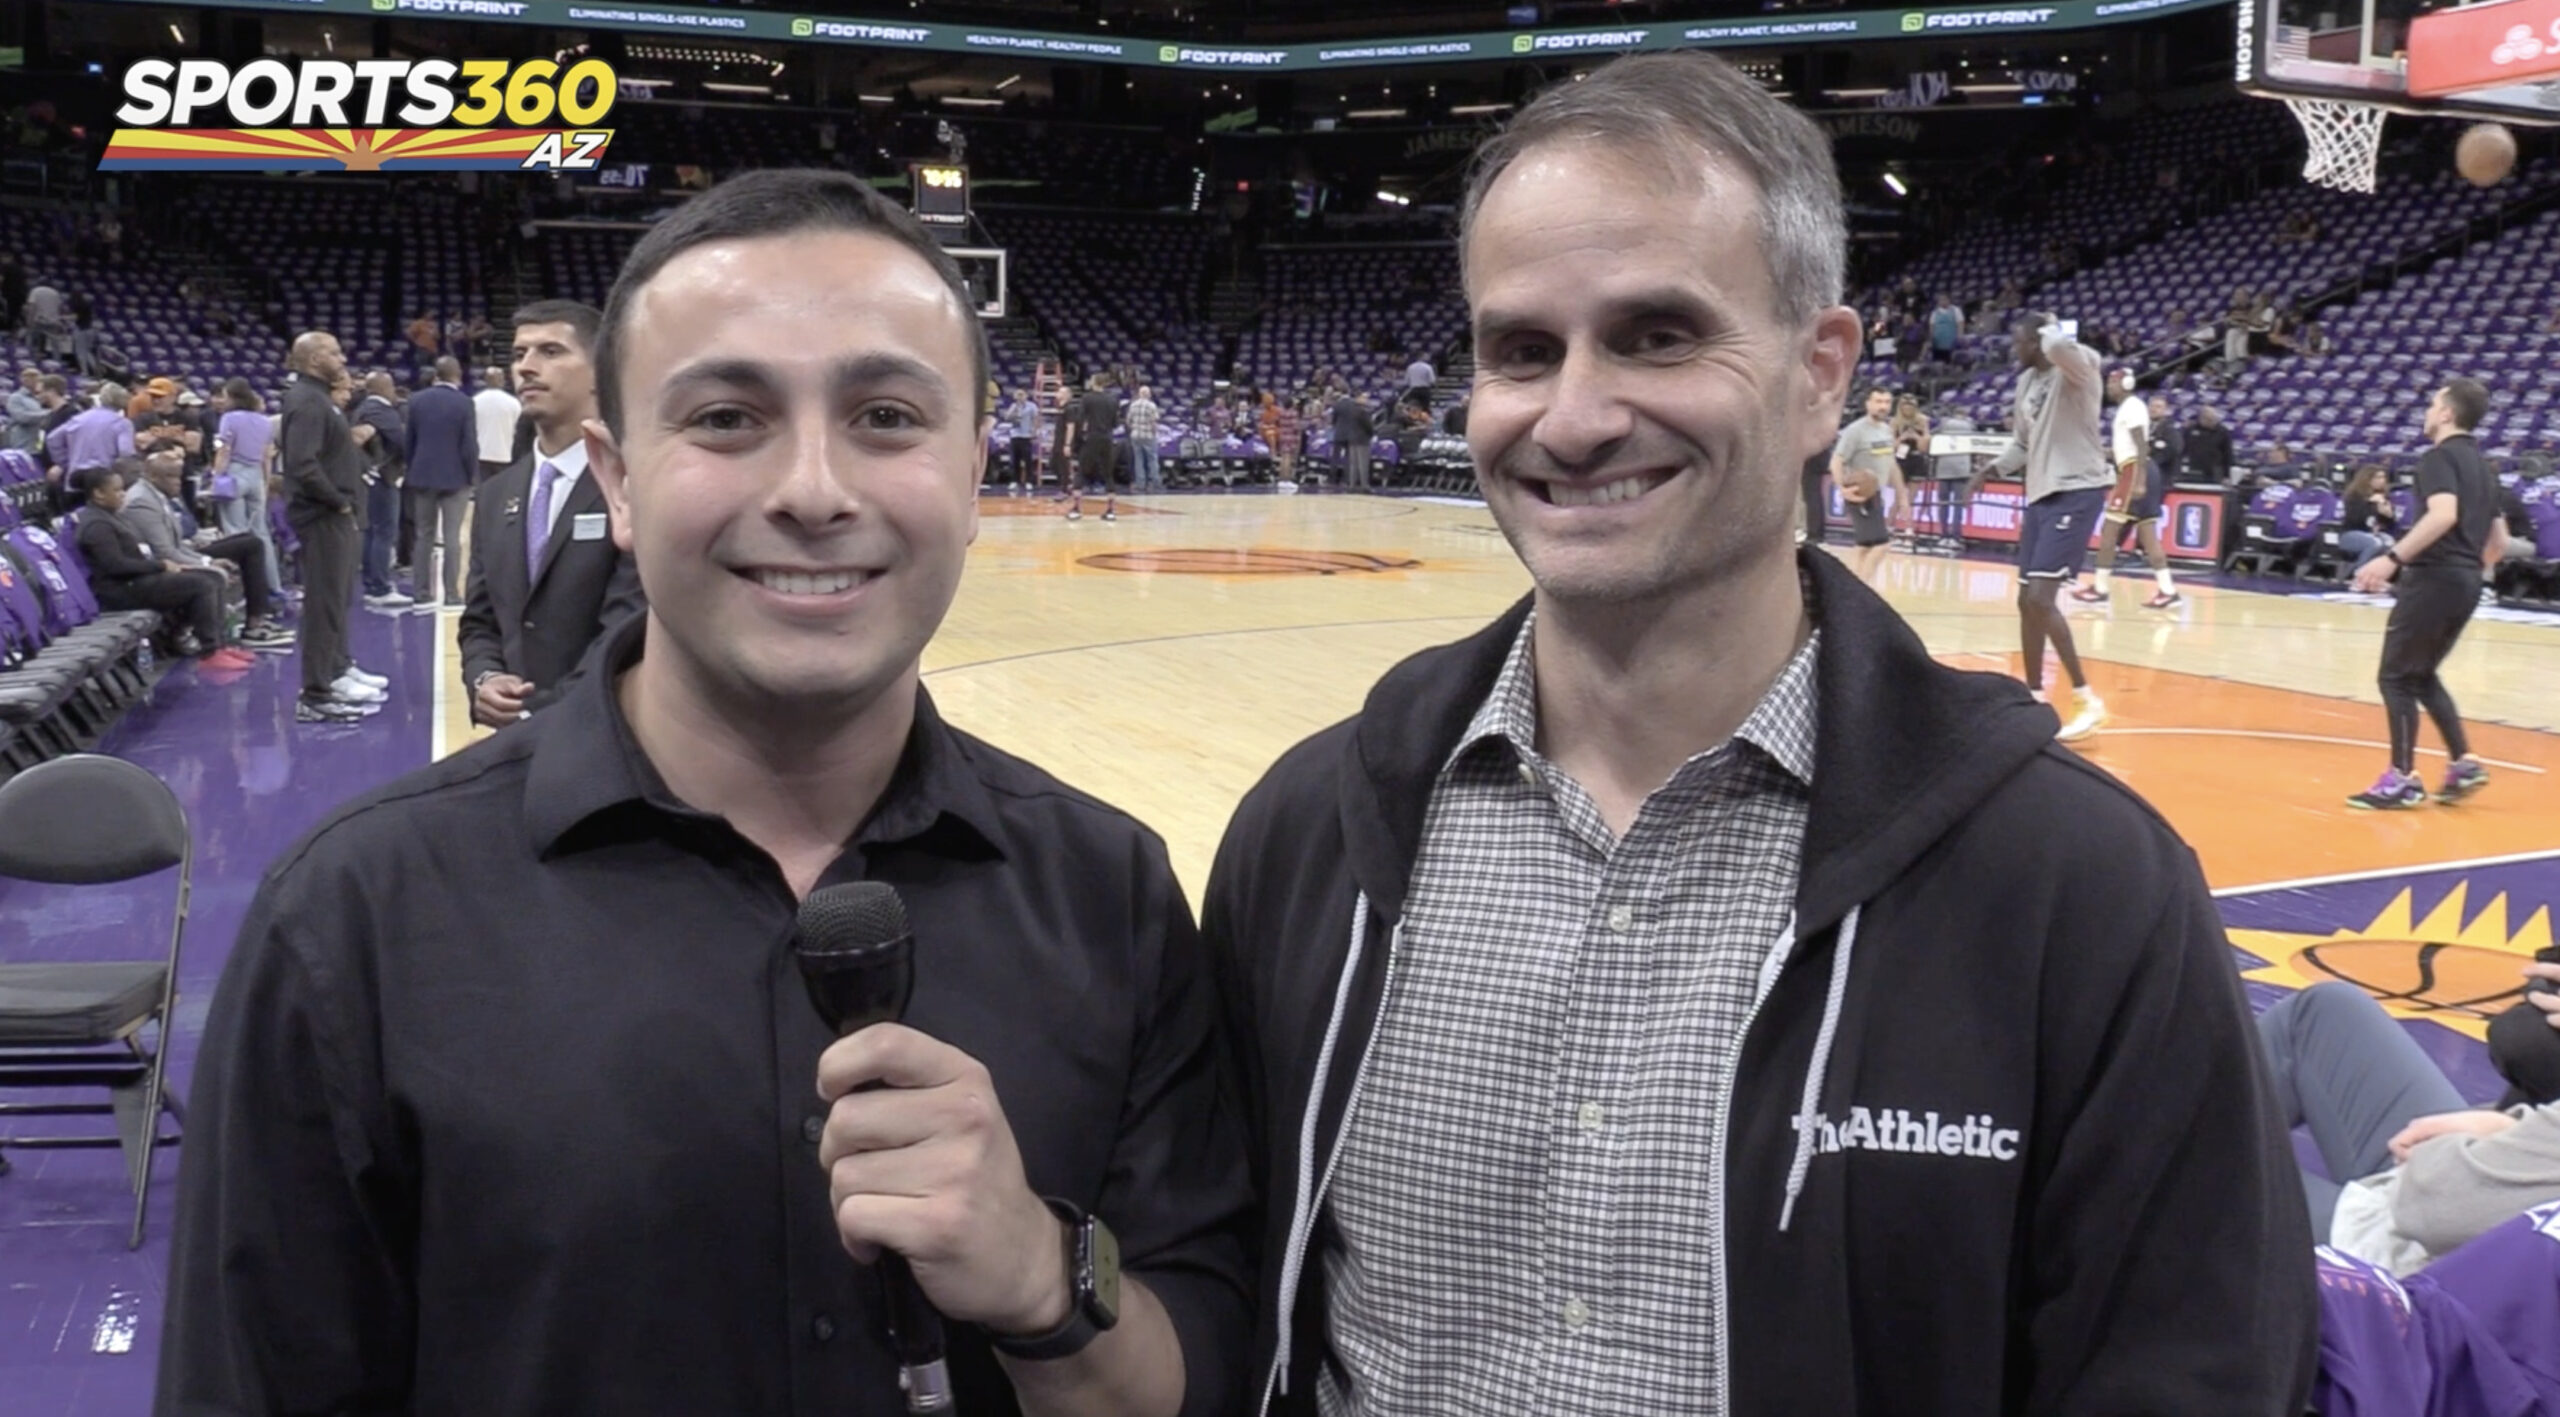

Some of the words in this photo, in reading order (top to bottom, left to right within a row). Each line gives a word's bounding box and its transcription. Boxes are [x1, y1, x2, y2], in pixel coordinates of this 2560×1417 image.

[398, 0, 529, 16] FOOTPRINT
[569, 8, 636, 21] ELIMINATING
[638, 12, 697, 25] SINGLE-USE
[699, 15, 746, 28] PLASTICS
[1927, 9, 2058, 28] FOOTPRINT
[815, 23, 932, 42] FOOTPRINT
[1685, 27, 1729, 39] HEALTHY
[1771, 23, 1816, 35] HEALTHY
[1818, 21, 1857, 33] PEOPLE
[966, 35, 1008, 47] HEALTHY
[1046, 41, 1086, 52] HEALTHY
[1088, 44, 1122, 55] PEOPLE
[1535, 31, 1650, 49] FOOTPRINT
[1180, 49, 1288, 64] FOOTPRINT
[1320, 48, 1375, 60] ELIMINATING
[1377, 45, 1428, 57] SINGLE-USE
[1430, 42, 1471, 54] PLASTICS
[1822, 114, 1921, 144] AMESON
[1403, 129, 1487, 160] JAMESO
[1847, 1105, 2020, 1161] Athletic
